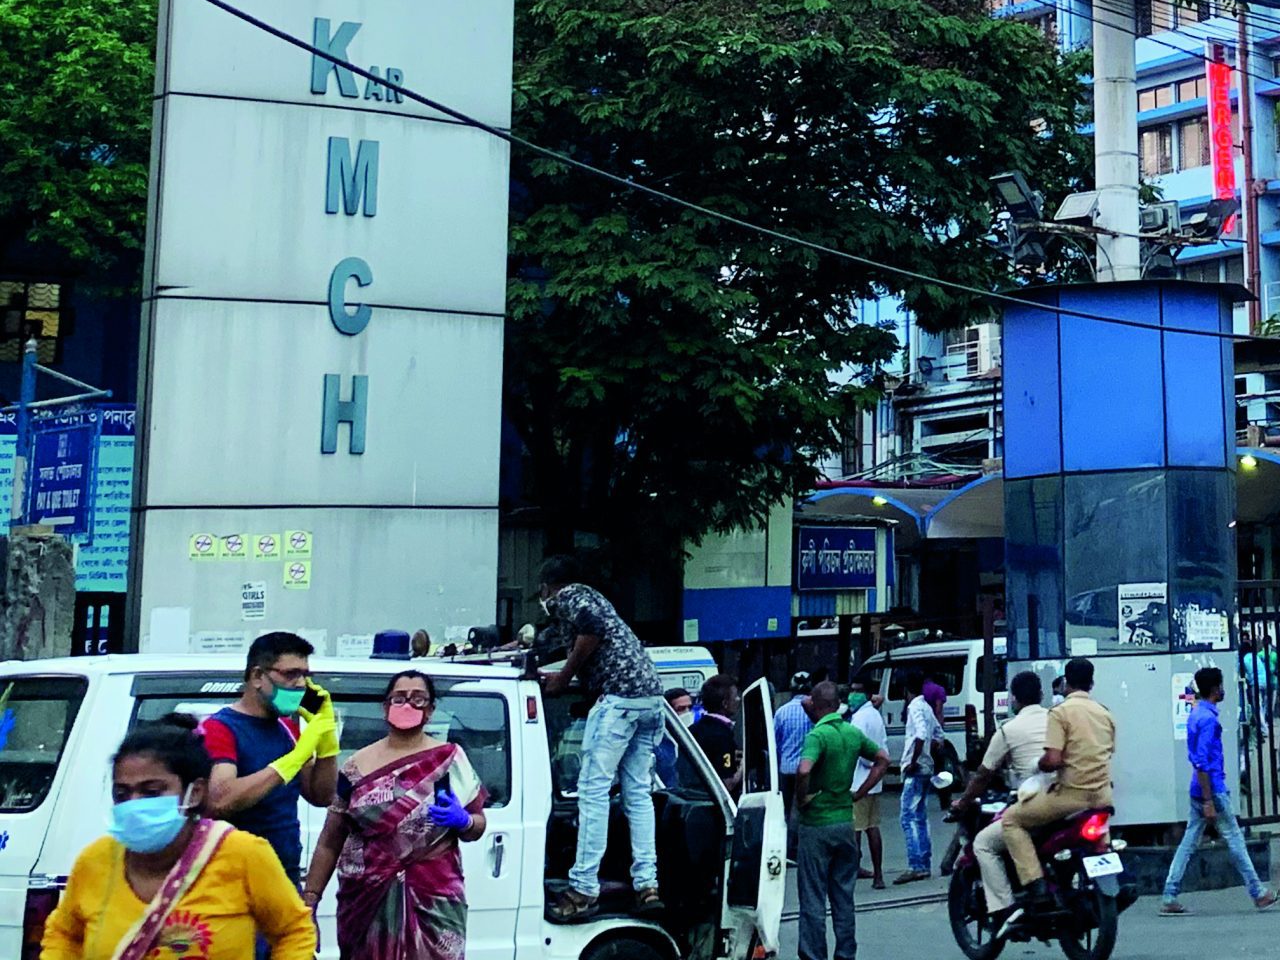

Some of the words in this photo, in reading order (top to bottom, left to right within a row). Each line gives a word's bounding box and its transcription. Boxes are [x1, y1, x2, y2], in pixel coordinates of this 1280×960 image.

[325, 136, 379, 217] M
[1209, 44, 1237, 234] EMERGEN
[328, 256, 373, 336] C
[320, 373, 369, 455] H
[722, 753, 731, 768] 3
